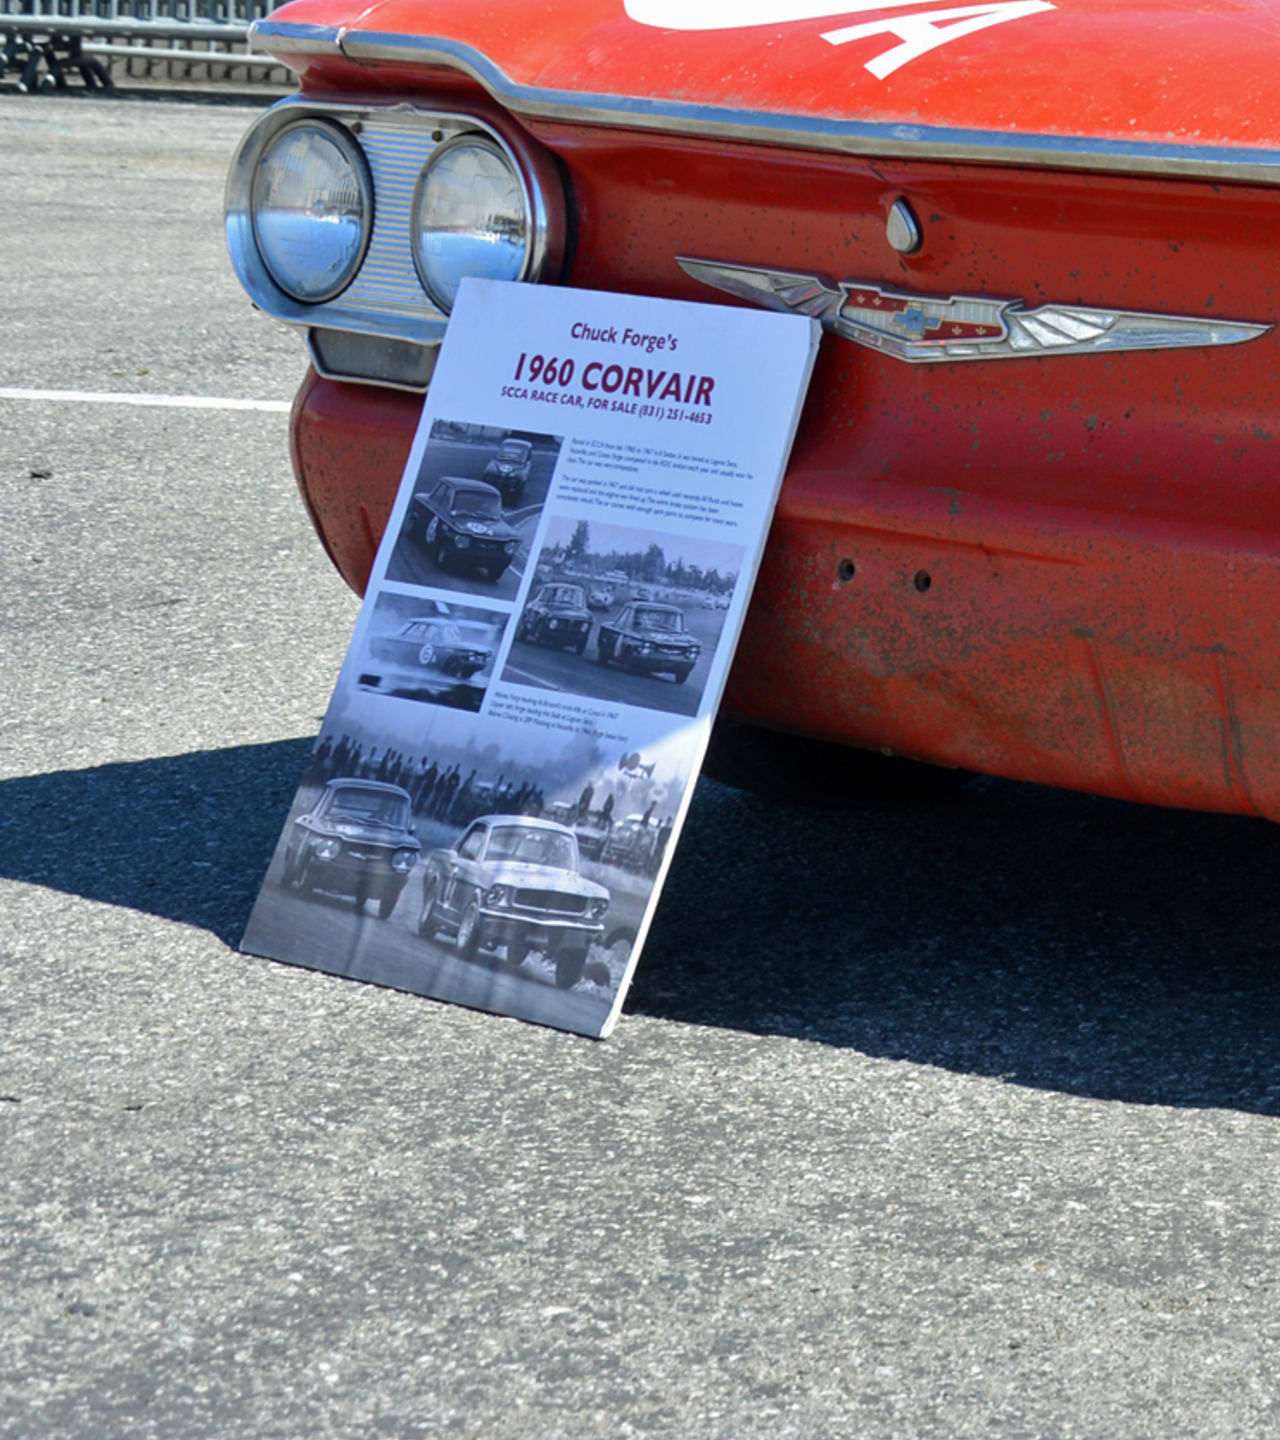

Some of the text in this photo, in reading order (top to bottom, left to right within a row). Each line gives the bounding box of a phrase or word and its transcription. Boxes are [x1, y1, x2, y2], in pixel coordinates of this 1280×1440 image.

[820, 0, 1058, 81] A
[570, 321, 679, 353] Chuck Forge's
[514, 353, 715, 407] 1960 CORVAIR
[501, 385, 528, 399] SCCA
[530, 390, 558, 404] RACE
[560, 394, 585, 409] CAR,
[587, 397, 609, 410] FOR
[610, 400, 637, 415] SALE
[638, 404, 665, 422] (831)
